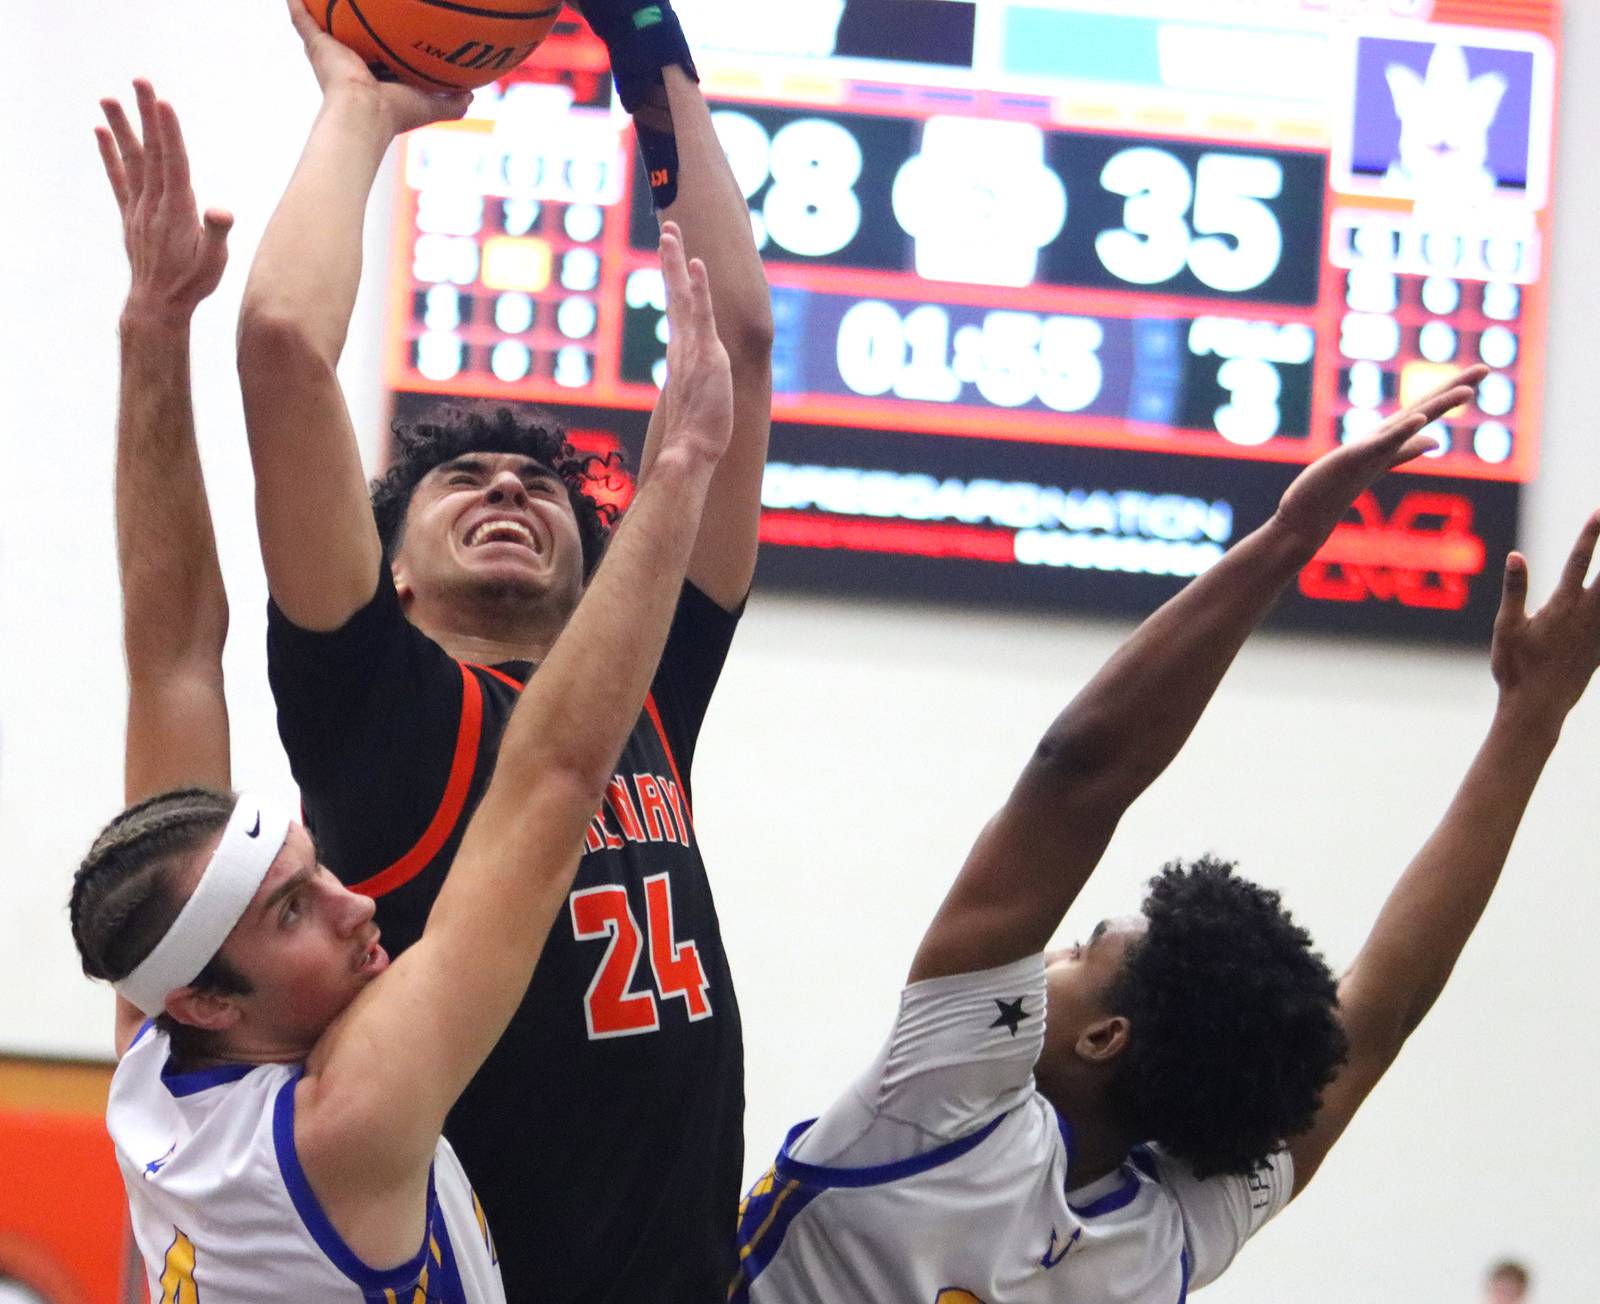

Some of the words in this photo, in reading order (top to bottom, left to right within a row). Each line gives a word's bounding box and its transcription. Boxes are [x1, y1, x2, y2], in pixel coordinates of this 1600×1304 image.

[1095, 146, 1283, 292] 35
[836, 299, 1103, 412] 01:55
[1214, 357, 1281, 446] 3
[569, 871, 713, 1040] 24
